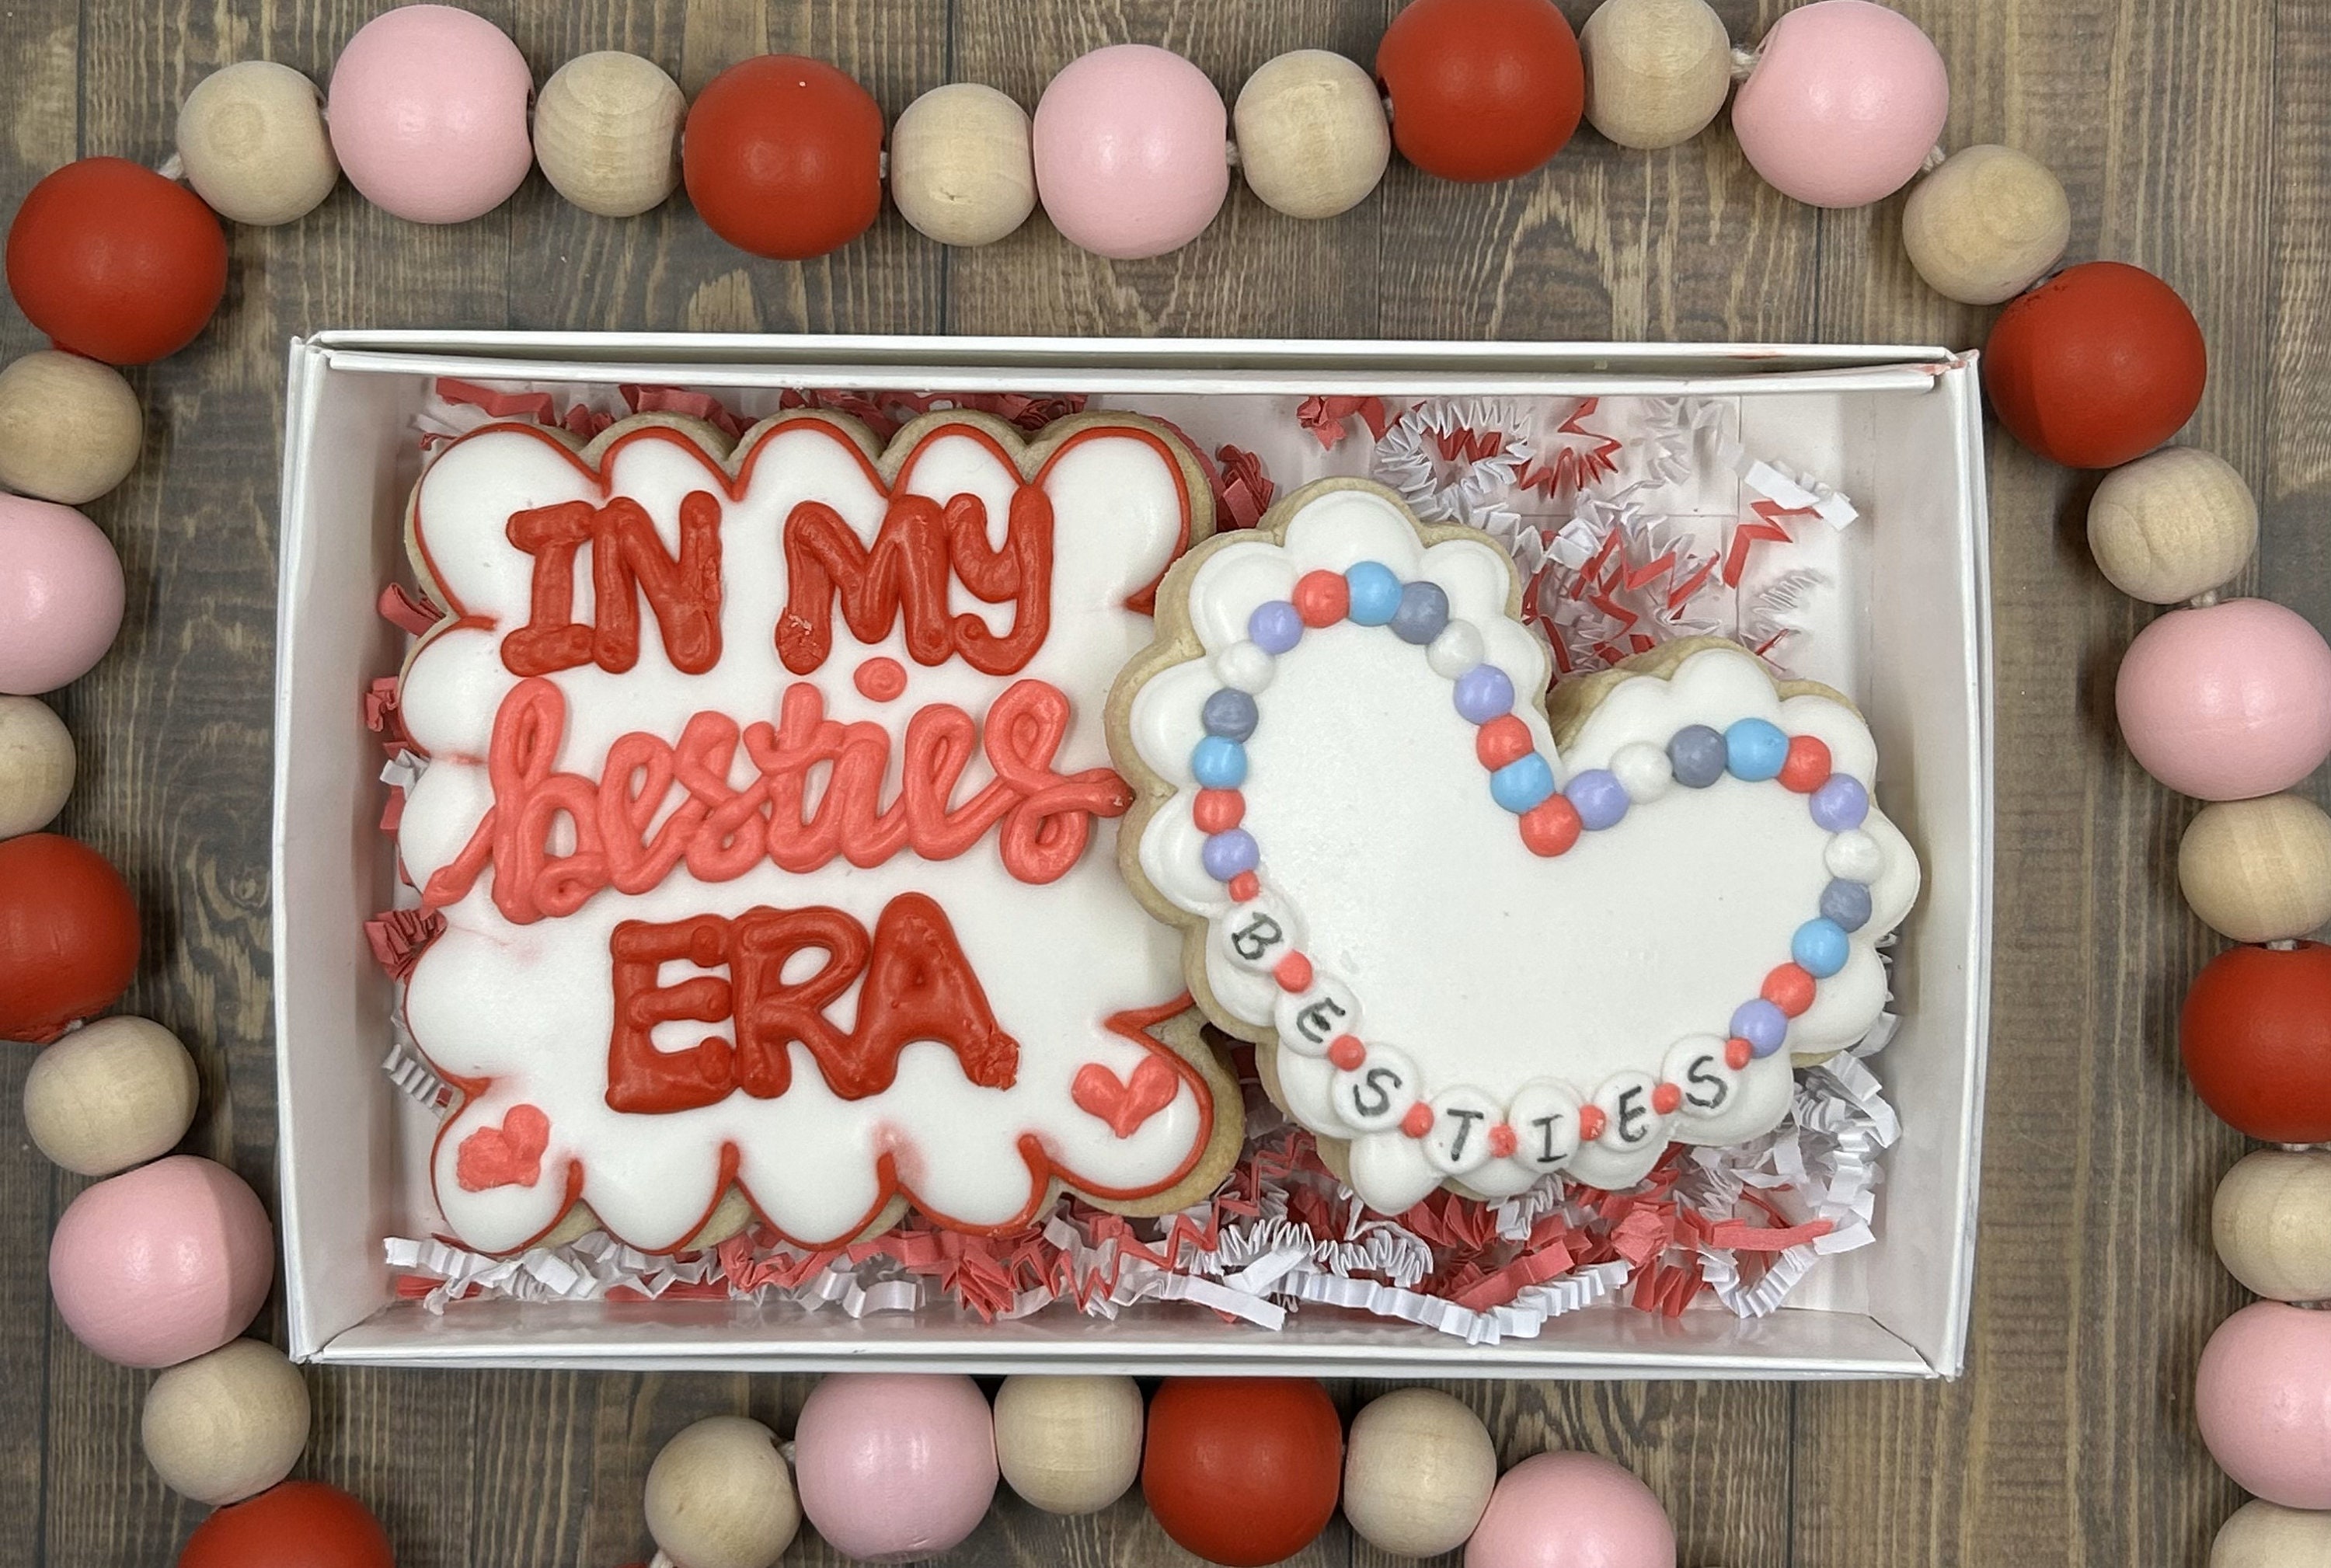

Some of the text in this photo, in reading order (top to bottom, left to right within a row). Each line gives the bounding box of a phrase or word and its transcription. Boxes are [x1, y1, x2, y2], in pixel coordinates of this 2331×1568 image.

[501, 486, 1054, 675] IN MY
[420, 657, 1134, 925] besties
[605, 892, 1021, 1113] ERA
[1231, 911, 1728, 1163] BESTIES
